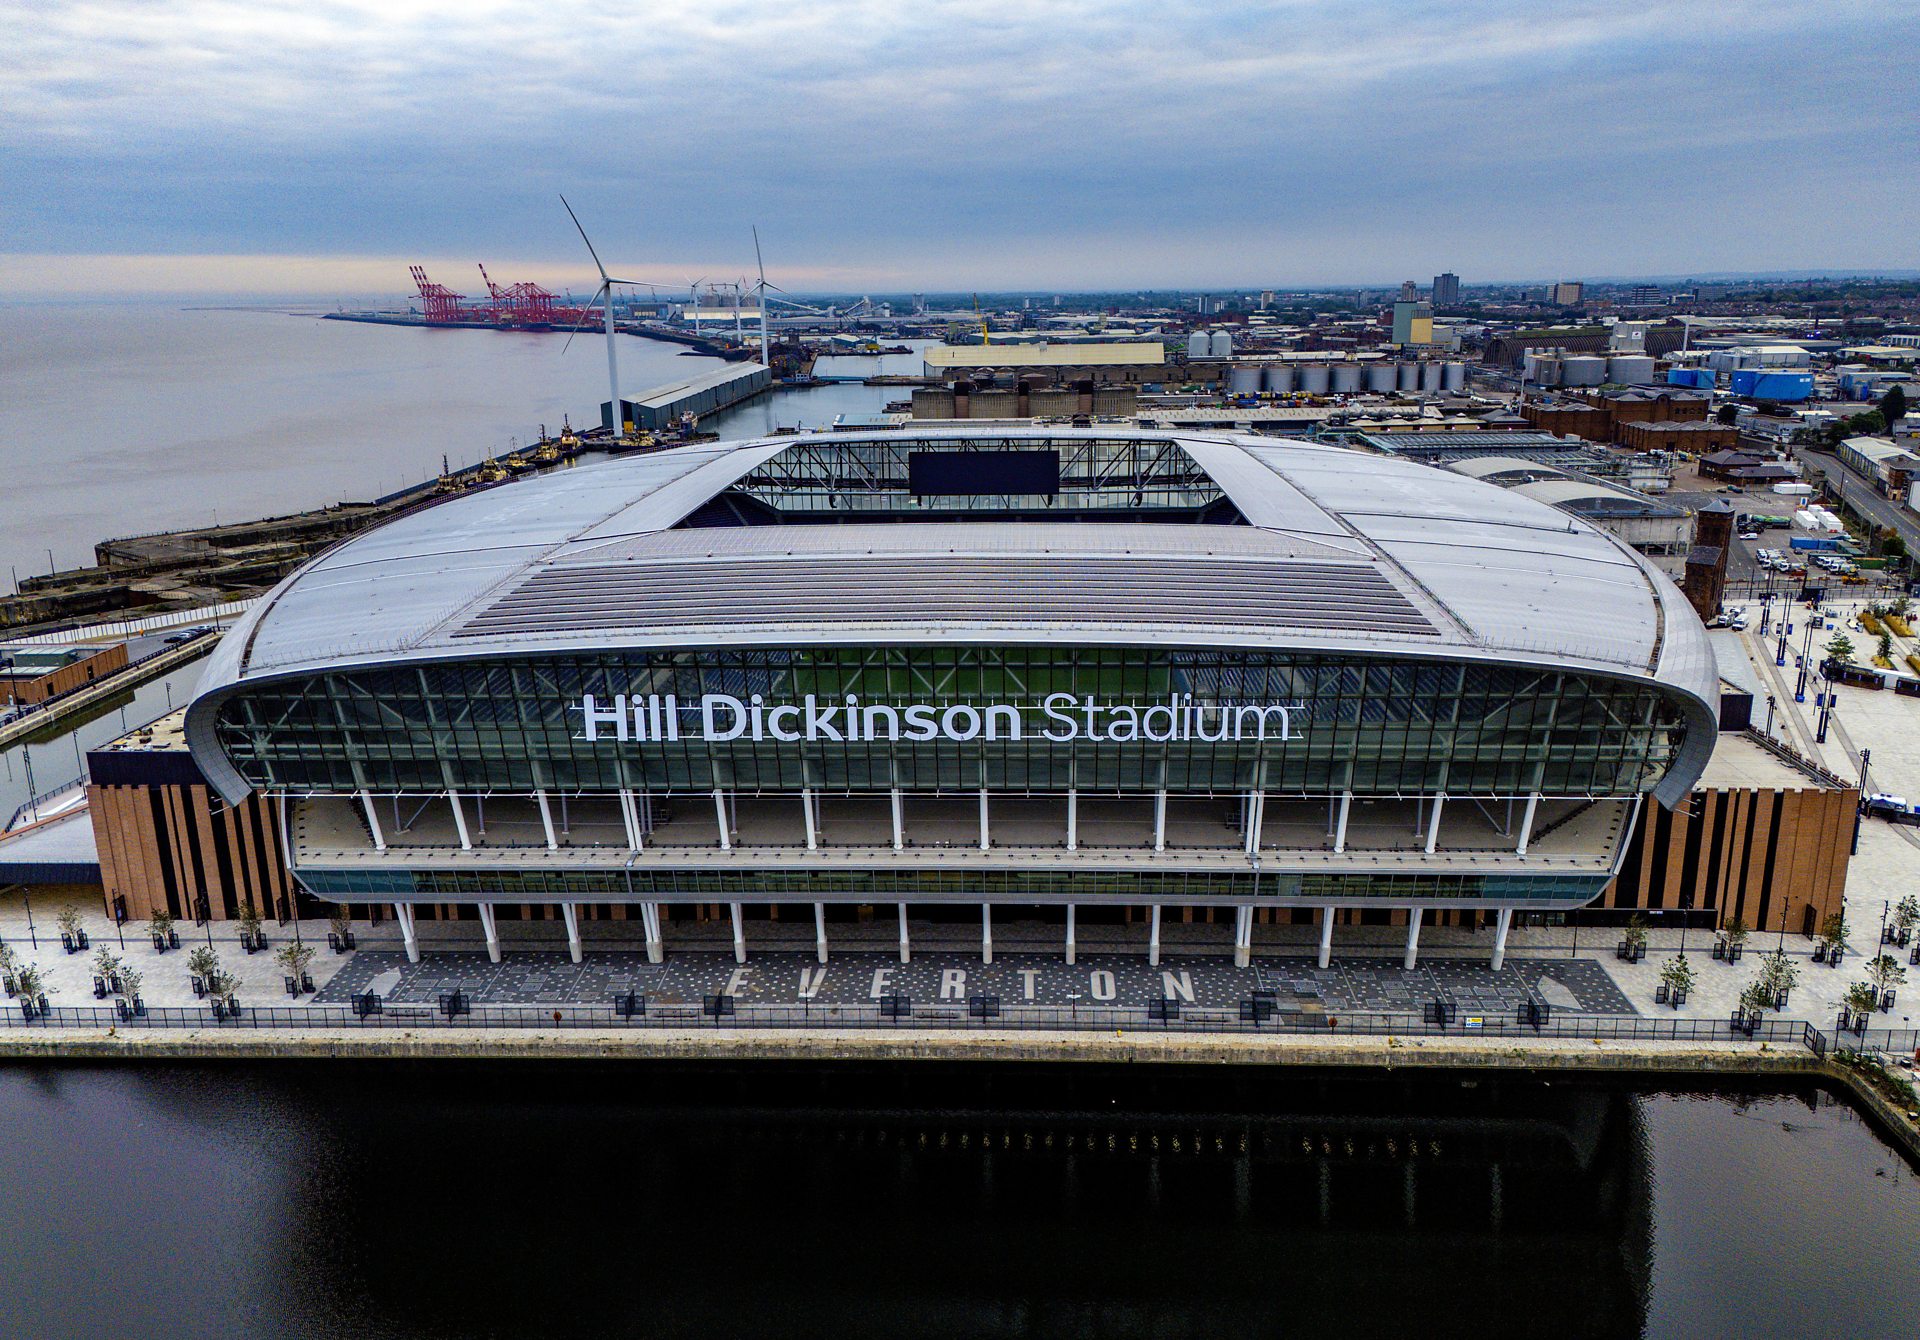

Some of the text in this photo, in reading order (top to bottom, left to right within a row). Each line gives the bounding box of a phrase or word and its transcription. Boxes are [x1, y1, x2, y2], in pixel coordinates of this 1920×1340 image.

[583, 692, 1289, 742] Hill Dickinson Stadium
[724, 968, 1196, 1002] EVERTON
